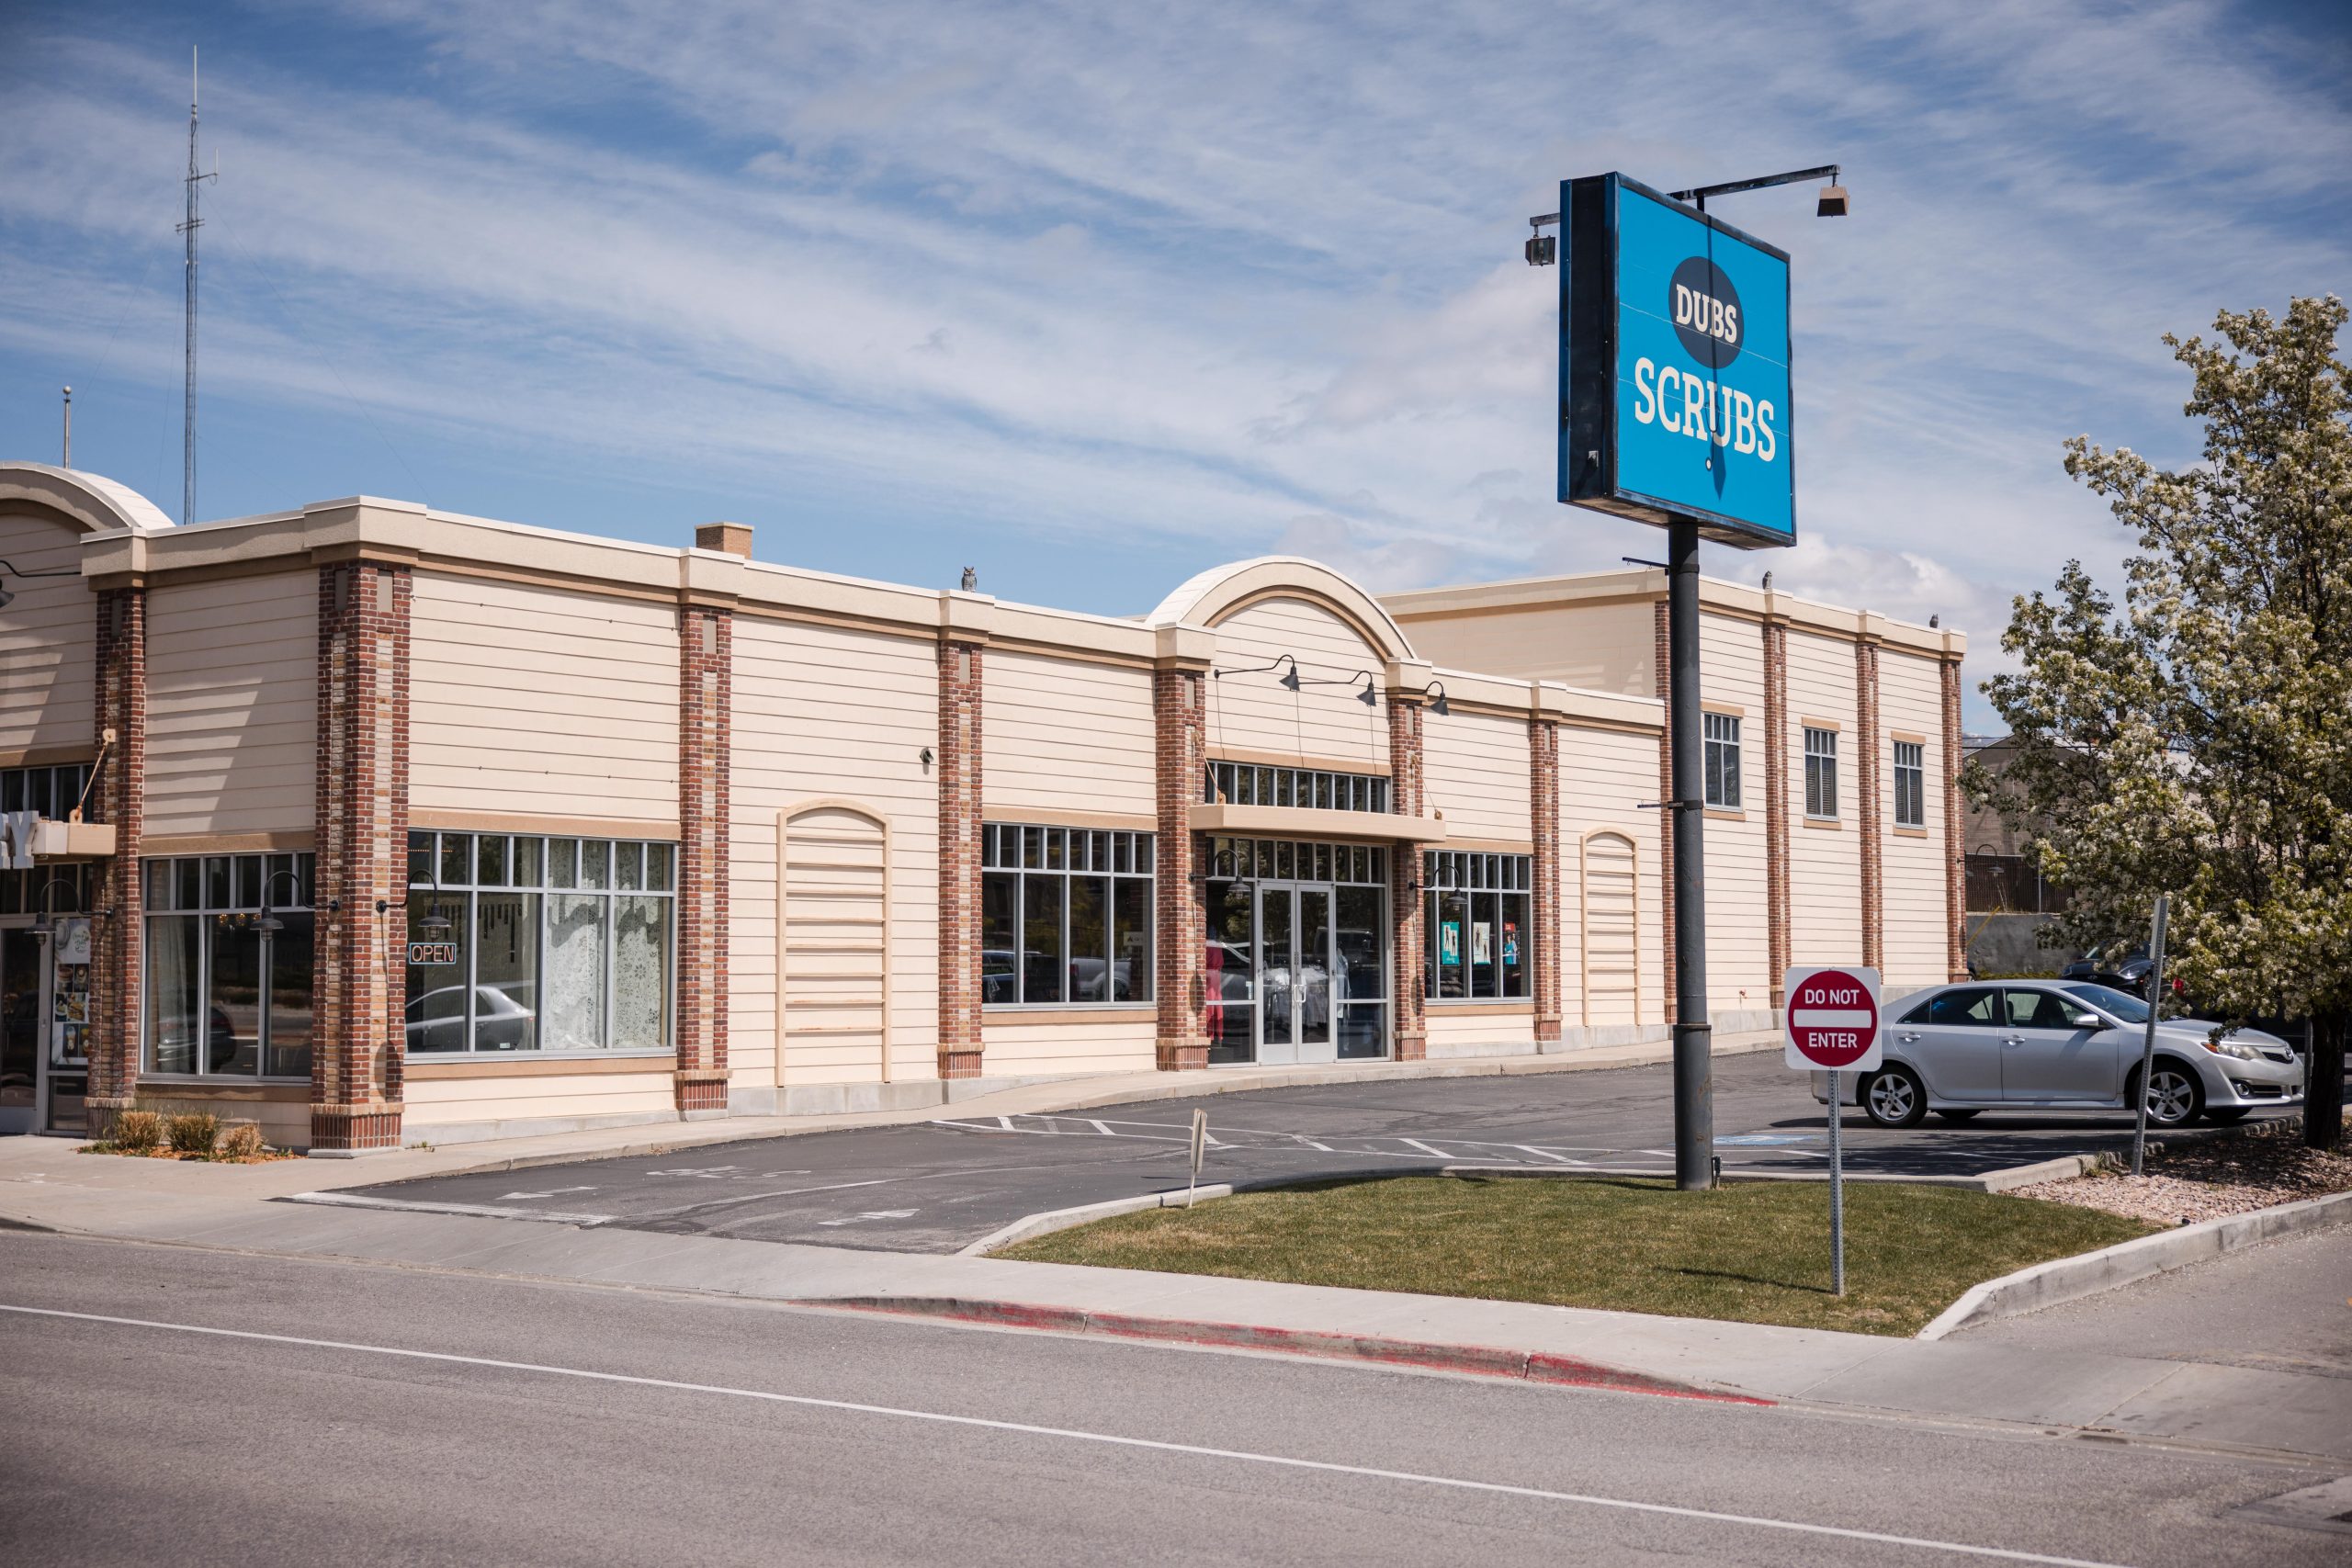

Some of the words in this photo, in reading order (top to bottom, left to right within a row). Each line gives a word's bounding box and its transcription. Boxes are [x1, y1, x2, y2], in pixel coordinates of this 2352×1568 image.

[1676, 284, 1737, 344] DUBS
[1634, 356, 1777, 462] SCRUBS
[0, 810, 39, 869] Y
[412, 945, 454, 963] OPEN
[1804, 989, 1826, 1004] DO
[1829, 989, 1860, 1004] NOT
[1808, 1032, 1858, 1048] ENTER
